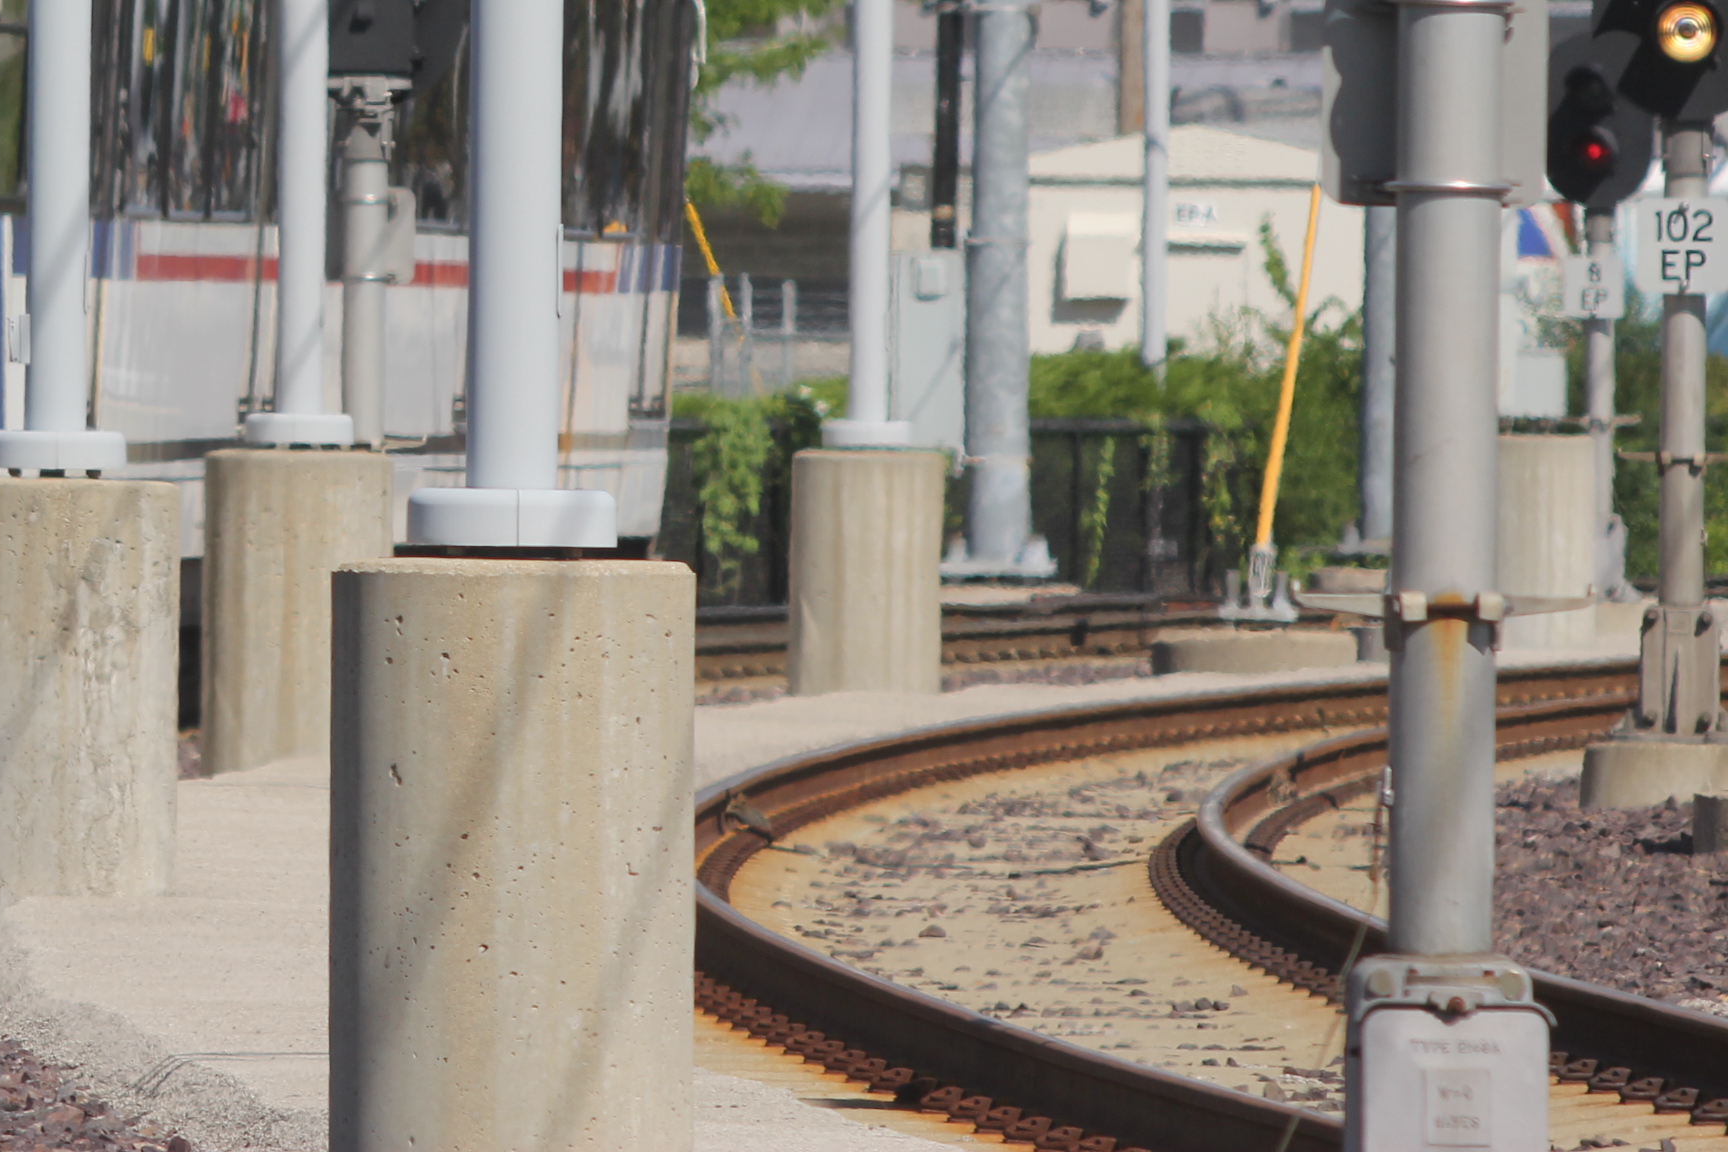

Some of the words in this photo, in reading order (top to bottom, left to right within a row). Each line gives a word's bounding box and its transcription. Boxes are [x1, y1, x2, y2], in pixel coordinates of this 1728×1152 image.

[1655, 208, 1714, 243] 102
[1661, 249, 1707, 281] EP
[1581, 288, 1609, 311] EP
